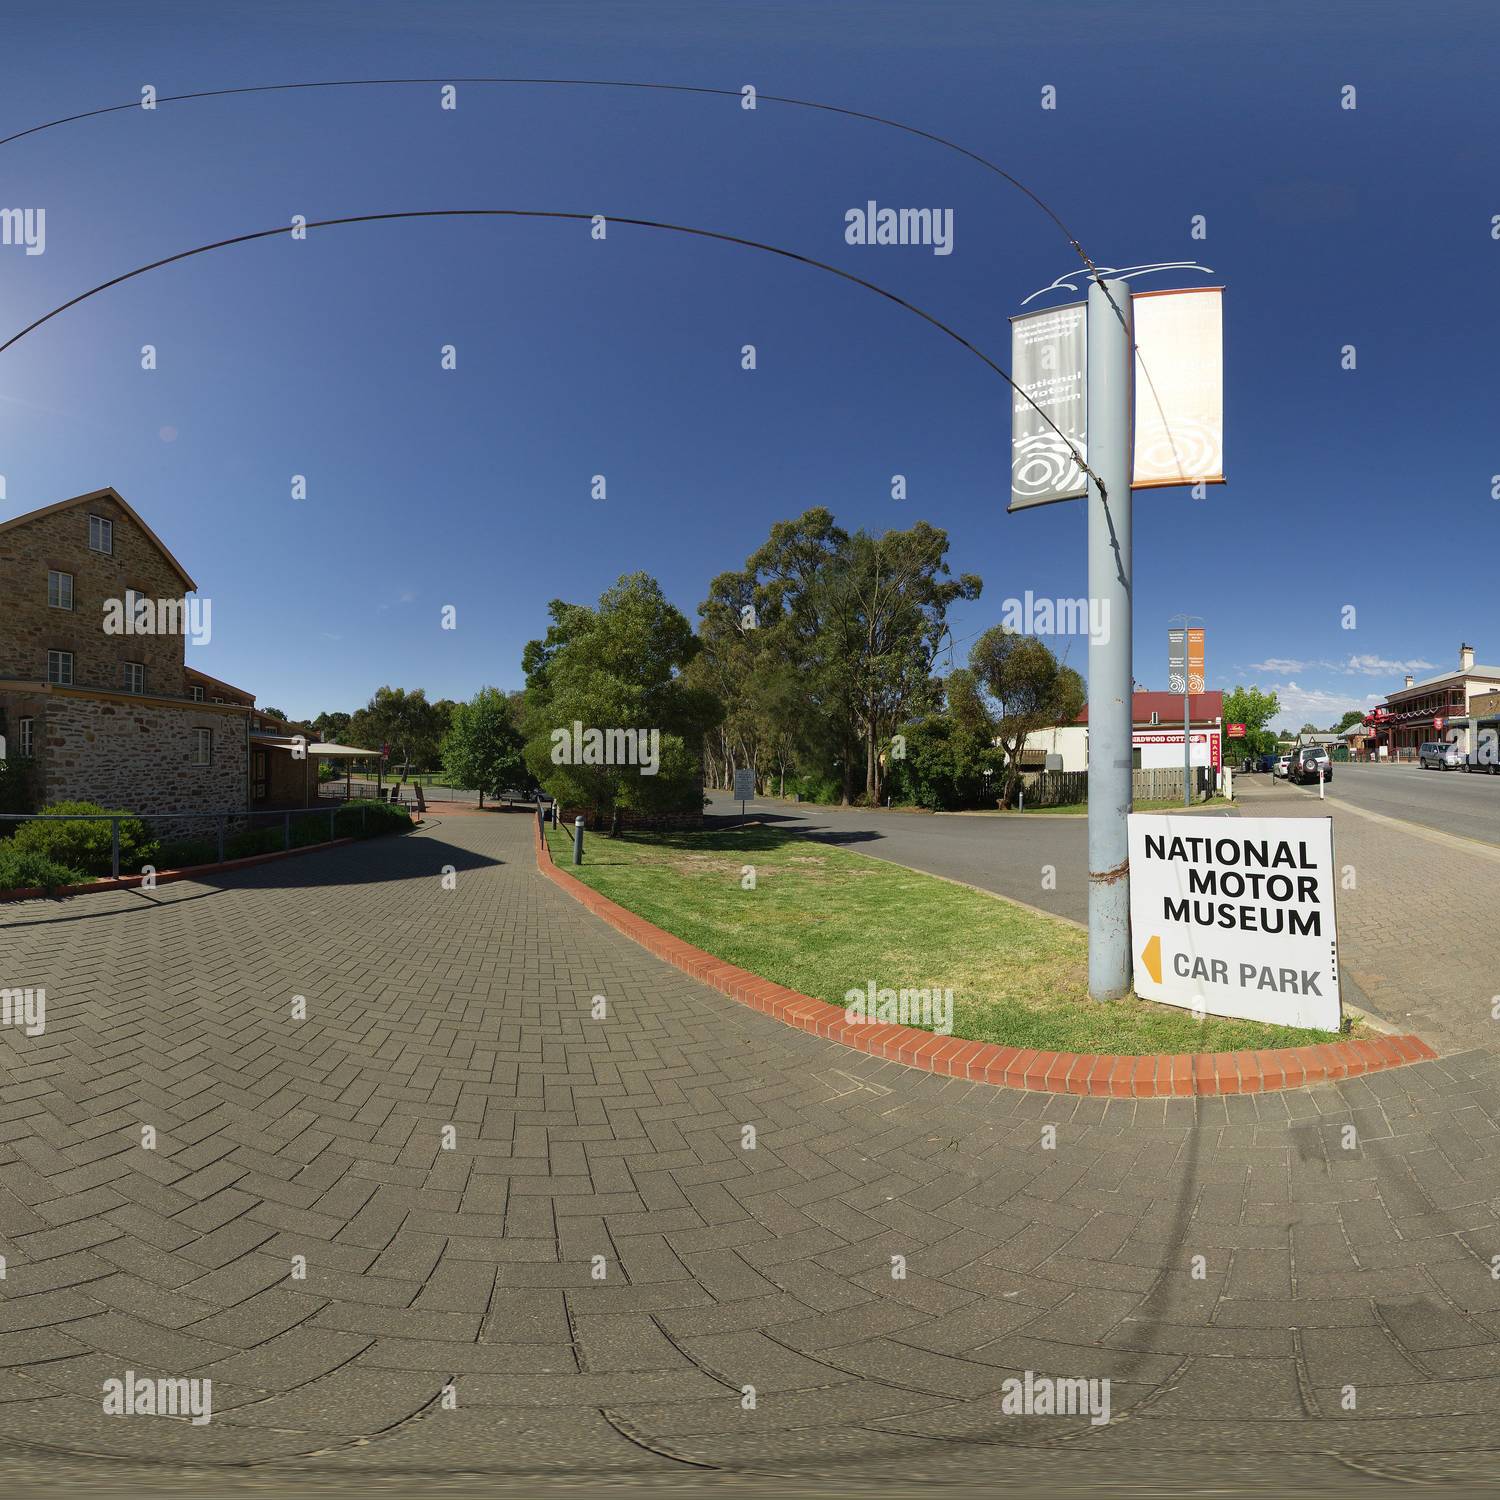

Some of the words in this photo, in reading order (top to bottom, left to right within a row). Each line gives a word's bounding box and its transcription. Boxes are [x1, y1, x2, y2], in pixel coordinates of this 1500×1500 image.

[1015, 371, 1081, 393] National
[1023, 385, 1073, 401] Motor
[1015, 393, 1081, 413] Museum
[1145, 835, 1318, 869] NATIONAL
[1189, 869, 1320, 903] MOTOR
[1164, 897, 1321, 936] MUSEUM
[1173, 953, 1229, 985] CAR
[1240, 963, 1323, 997] PARK
